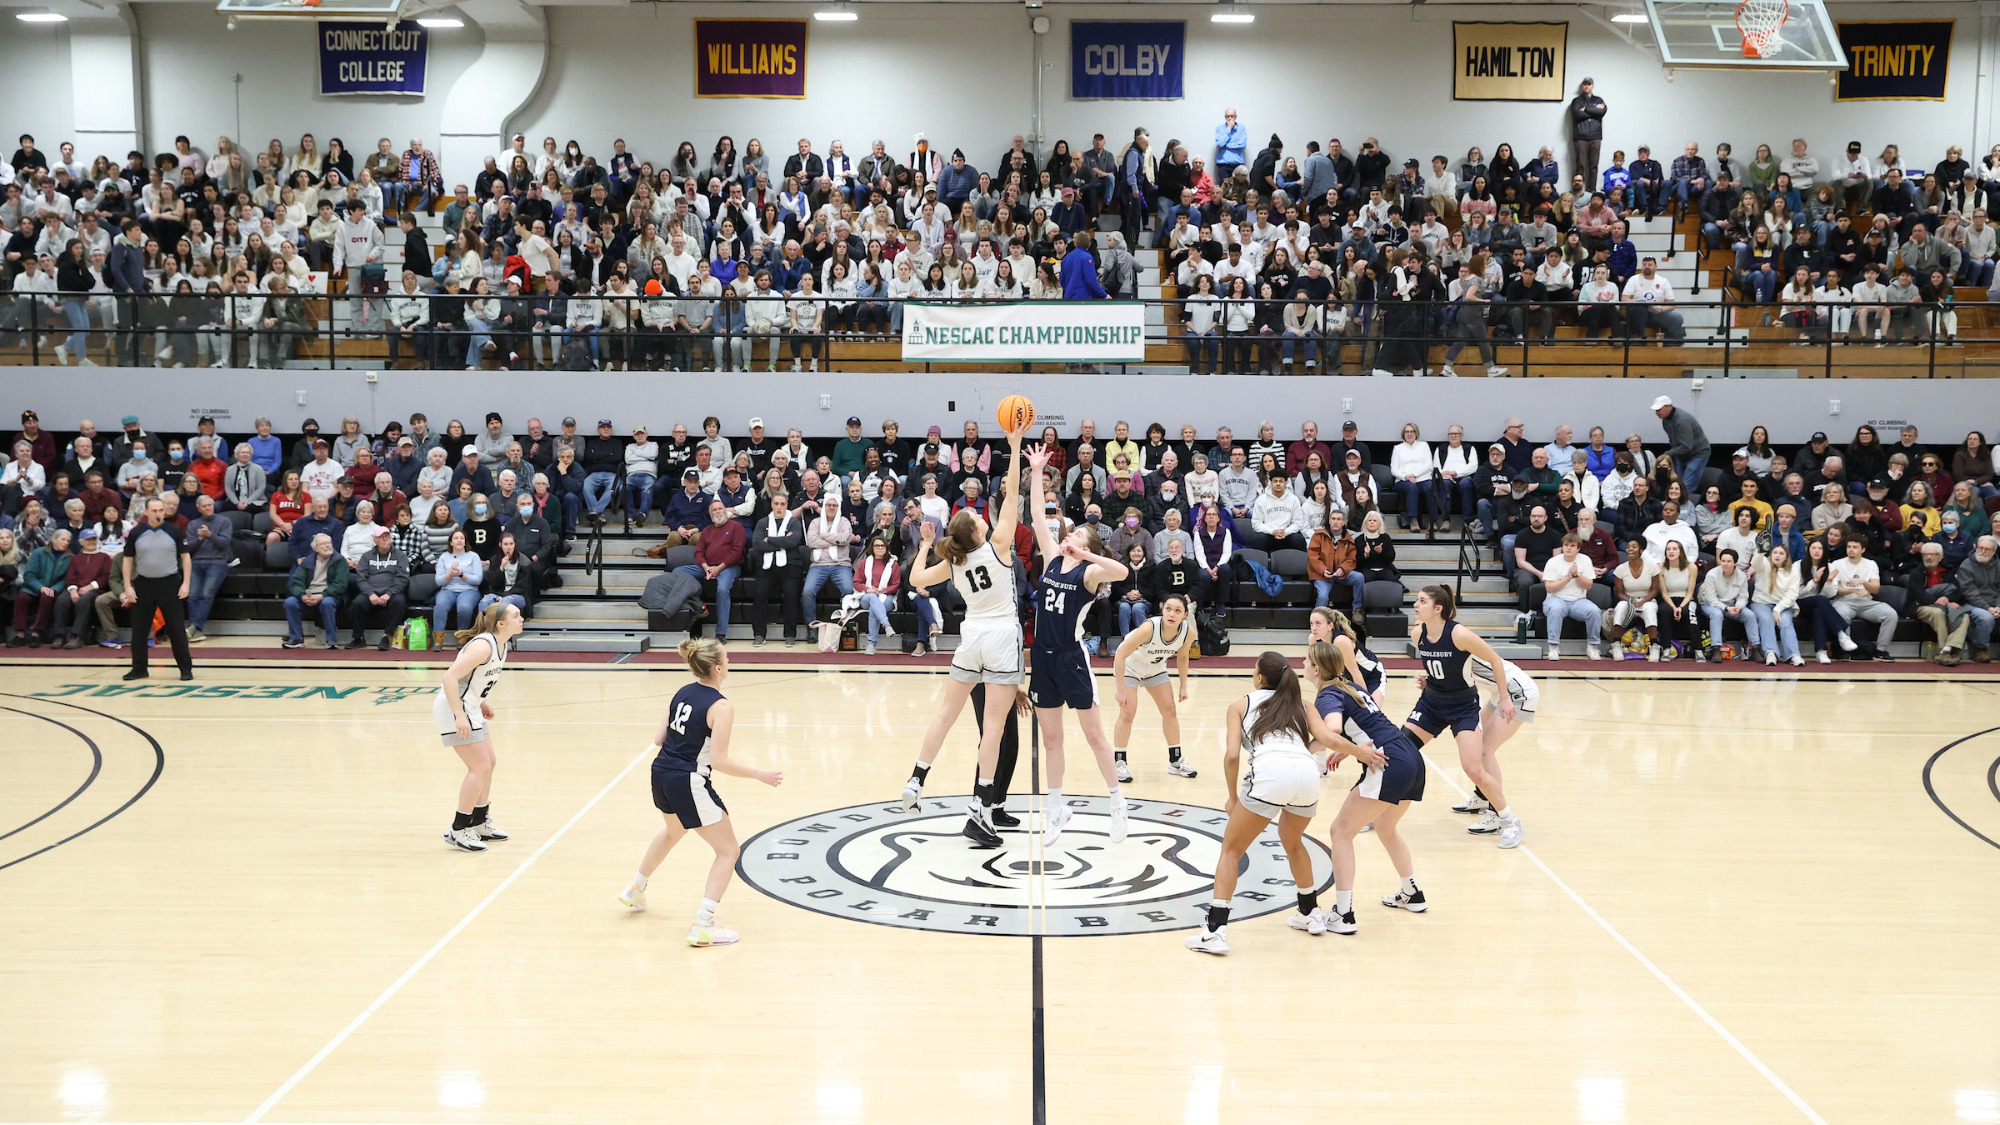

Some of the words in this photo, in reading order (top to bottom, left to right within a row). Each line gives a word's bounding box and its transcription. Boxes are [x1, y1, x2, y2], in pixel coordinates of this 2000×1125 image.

[325, 30, 420, 52] CONNECTICUT
[707, 43, 797, 75] WILLIAMS
[1084, 44, 1170, 76] COLBY
[1465, 46, 1554, 78] HAMILTON
[1850, 45, 1935, 77] TRINITY
[339, 61, 405, 83] COLLEGE
[925, 327, 994, 345] NESCAC
[999, 326, 1141, 345] CHAMPIONSHIP
[474, 529, 487, 544] B
[965, 565, 992, 593] 13
[1172, 571, 1185, 586] B
[1045, 588, 1066, 615] 24
[1426, 659, 1445, 680] 10
[31, 683, 367, 700] NESCAC
[1030, 691, 1039, 704] M
[670, 701, 693, 736] 12
[1410, 710, 1423, 722] M
[779, 875, 999, 928] POLAR
